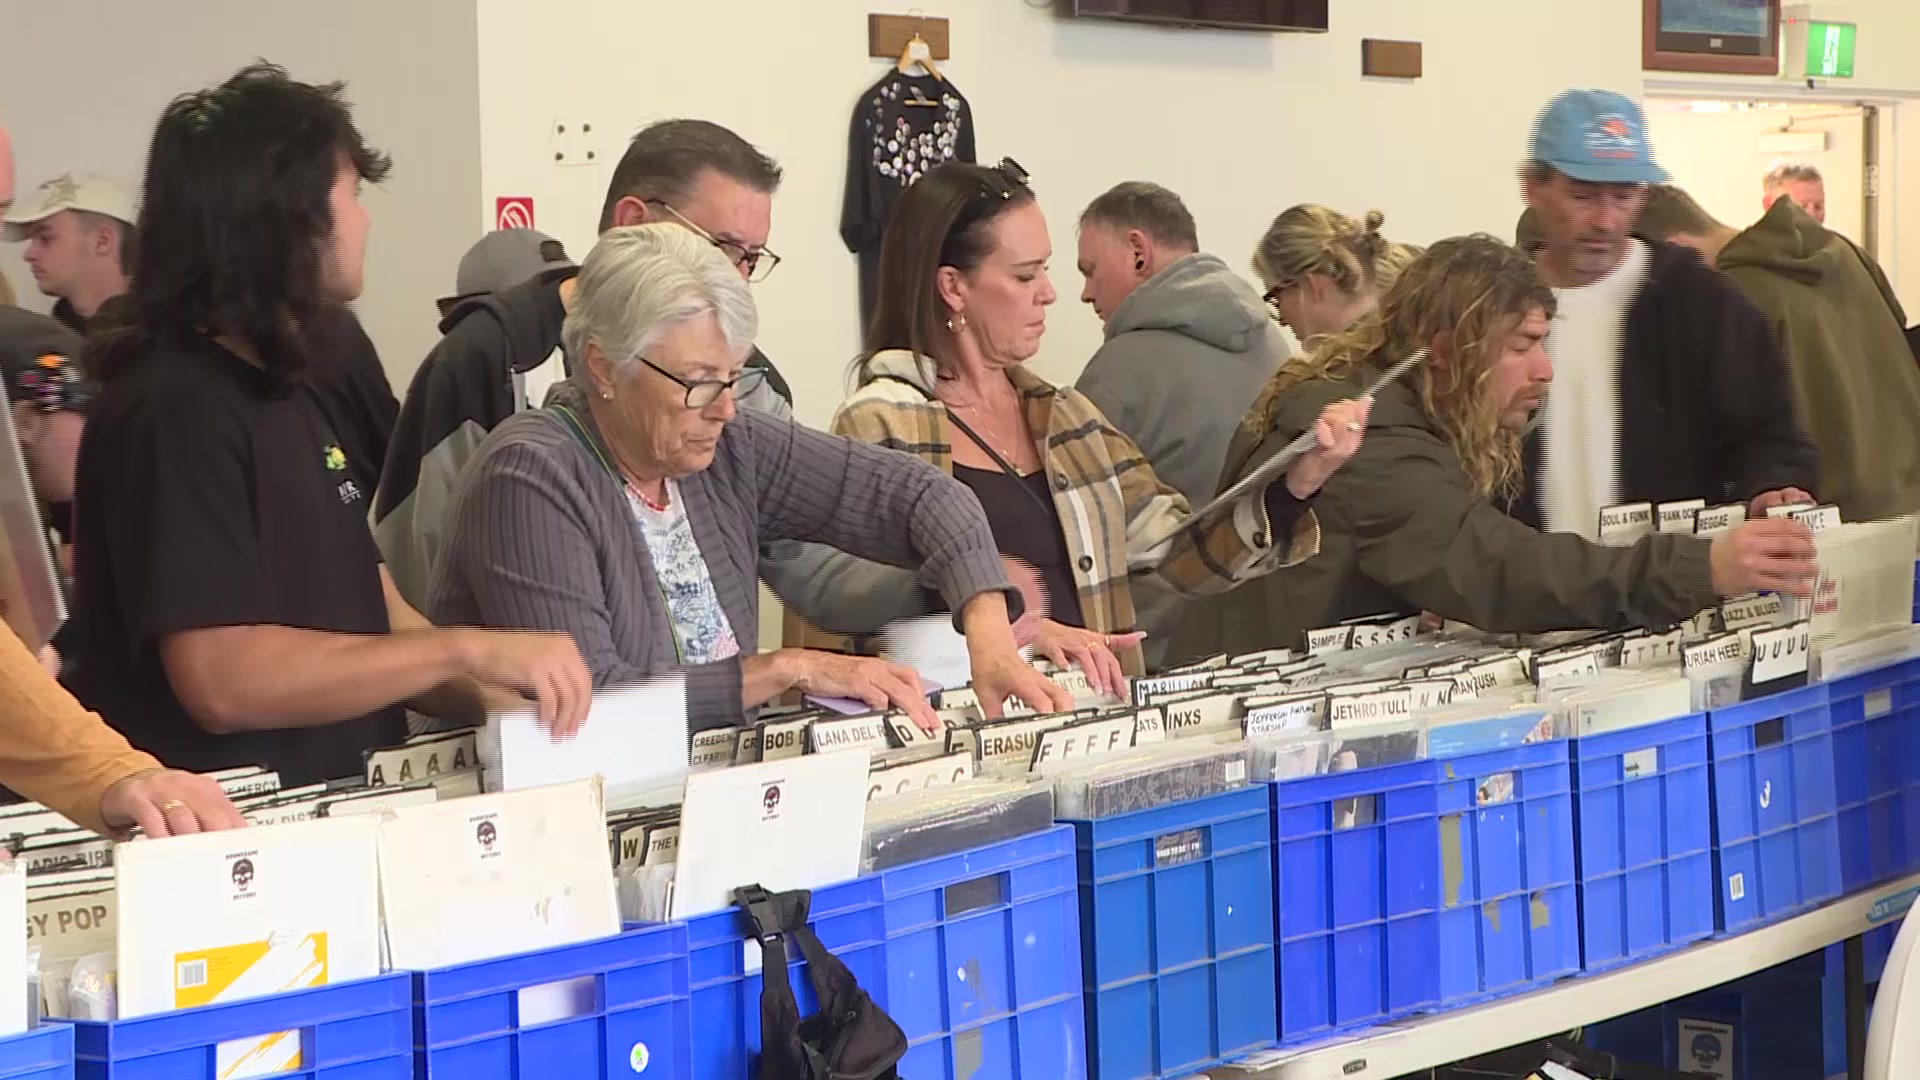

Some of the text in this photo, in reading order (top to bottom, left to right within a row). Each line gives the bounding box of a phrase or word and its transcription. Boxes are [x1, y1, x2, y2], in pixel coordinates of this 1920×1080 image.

[1603, 510, 1649, 526] SOUL & FUNK
[1661, 510, 1681, 521] FRANK
[1699, 514, 1728, 530] REGGAE
[1708, 613, 1716, 631] Z
[1724, 608, 1747, 622] JAZZ
[1748, 607, 1755, 618] &
[1311, 633, 1344, 649] SIMPLE
[1354, 626, 1411, 649] S S S S
[1756, 633, 1808, 662] U U U U
[1686, 651, 1716, 668] URIAH
[1168, 709, 1201, 730] INXS
[1333, 699, 1408, 721] JETHRO TULL
[765, 731, 794, 750] BOB
[818, 729, 851, 746] LANA
[853, 726, 873, 742] DEL
[1108, 730, 1121, 751] F
[371, 747, 466, 787] A A A A
[624, 838, 639, 860] W
[652, 837, 672, 852] THE
[58, 905, 107, 933] POP
